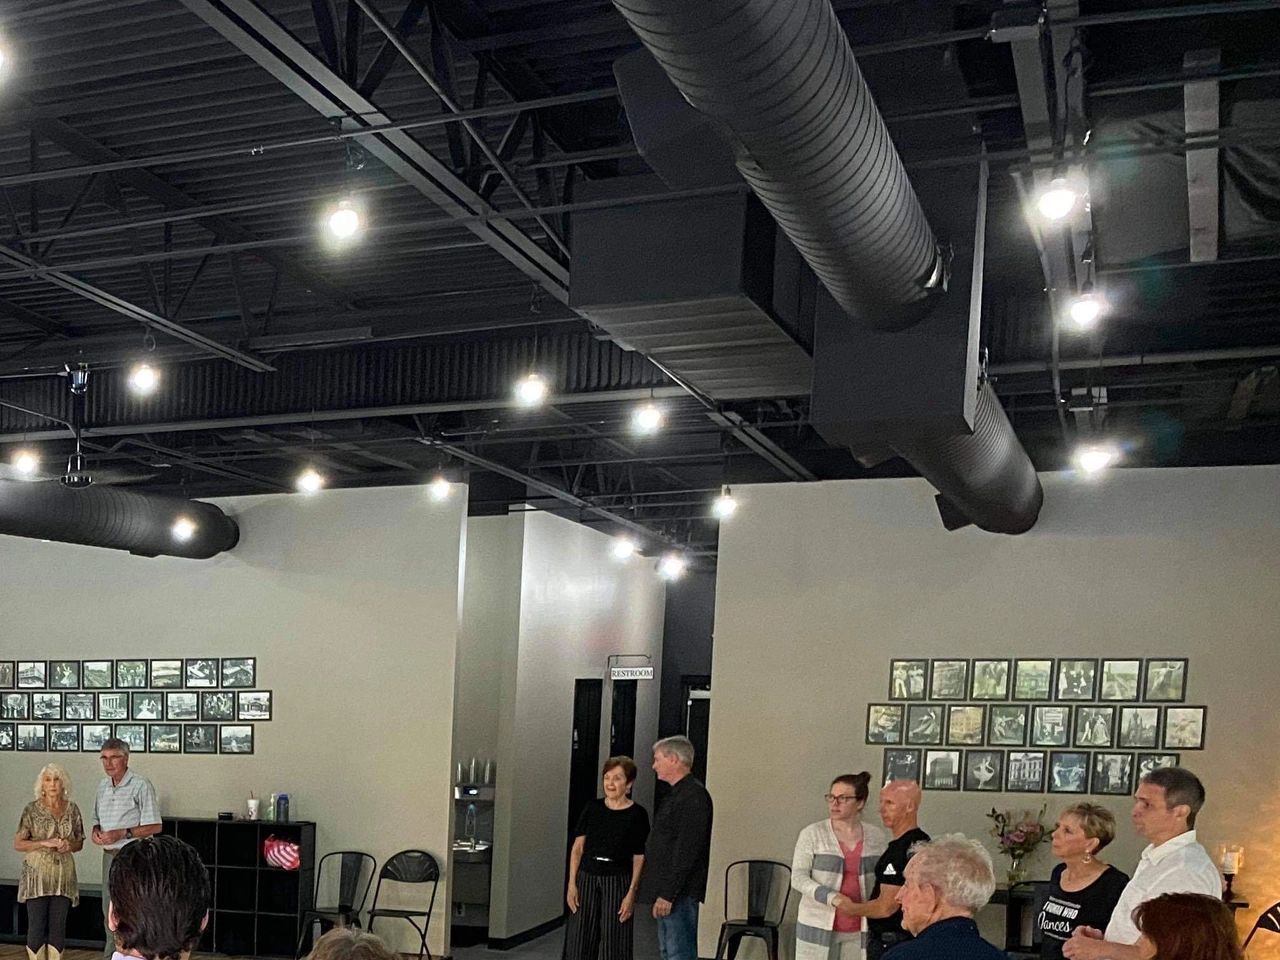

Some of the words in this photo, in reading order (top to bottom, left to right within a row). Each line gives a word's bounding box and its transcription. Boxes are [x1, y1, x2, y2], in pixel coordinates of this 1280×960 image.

[612, 669, 653, 678] RESTROOM
[1061, 906, 1079, 920] WHO
[1037, 911, 1071, 933] Dances
